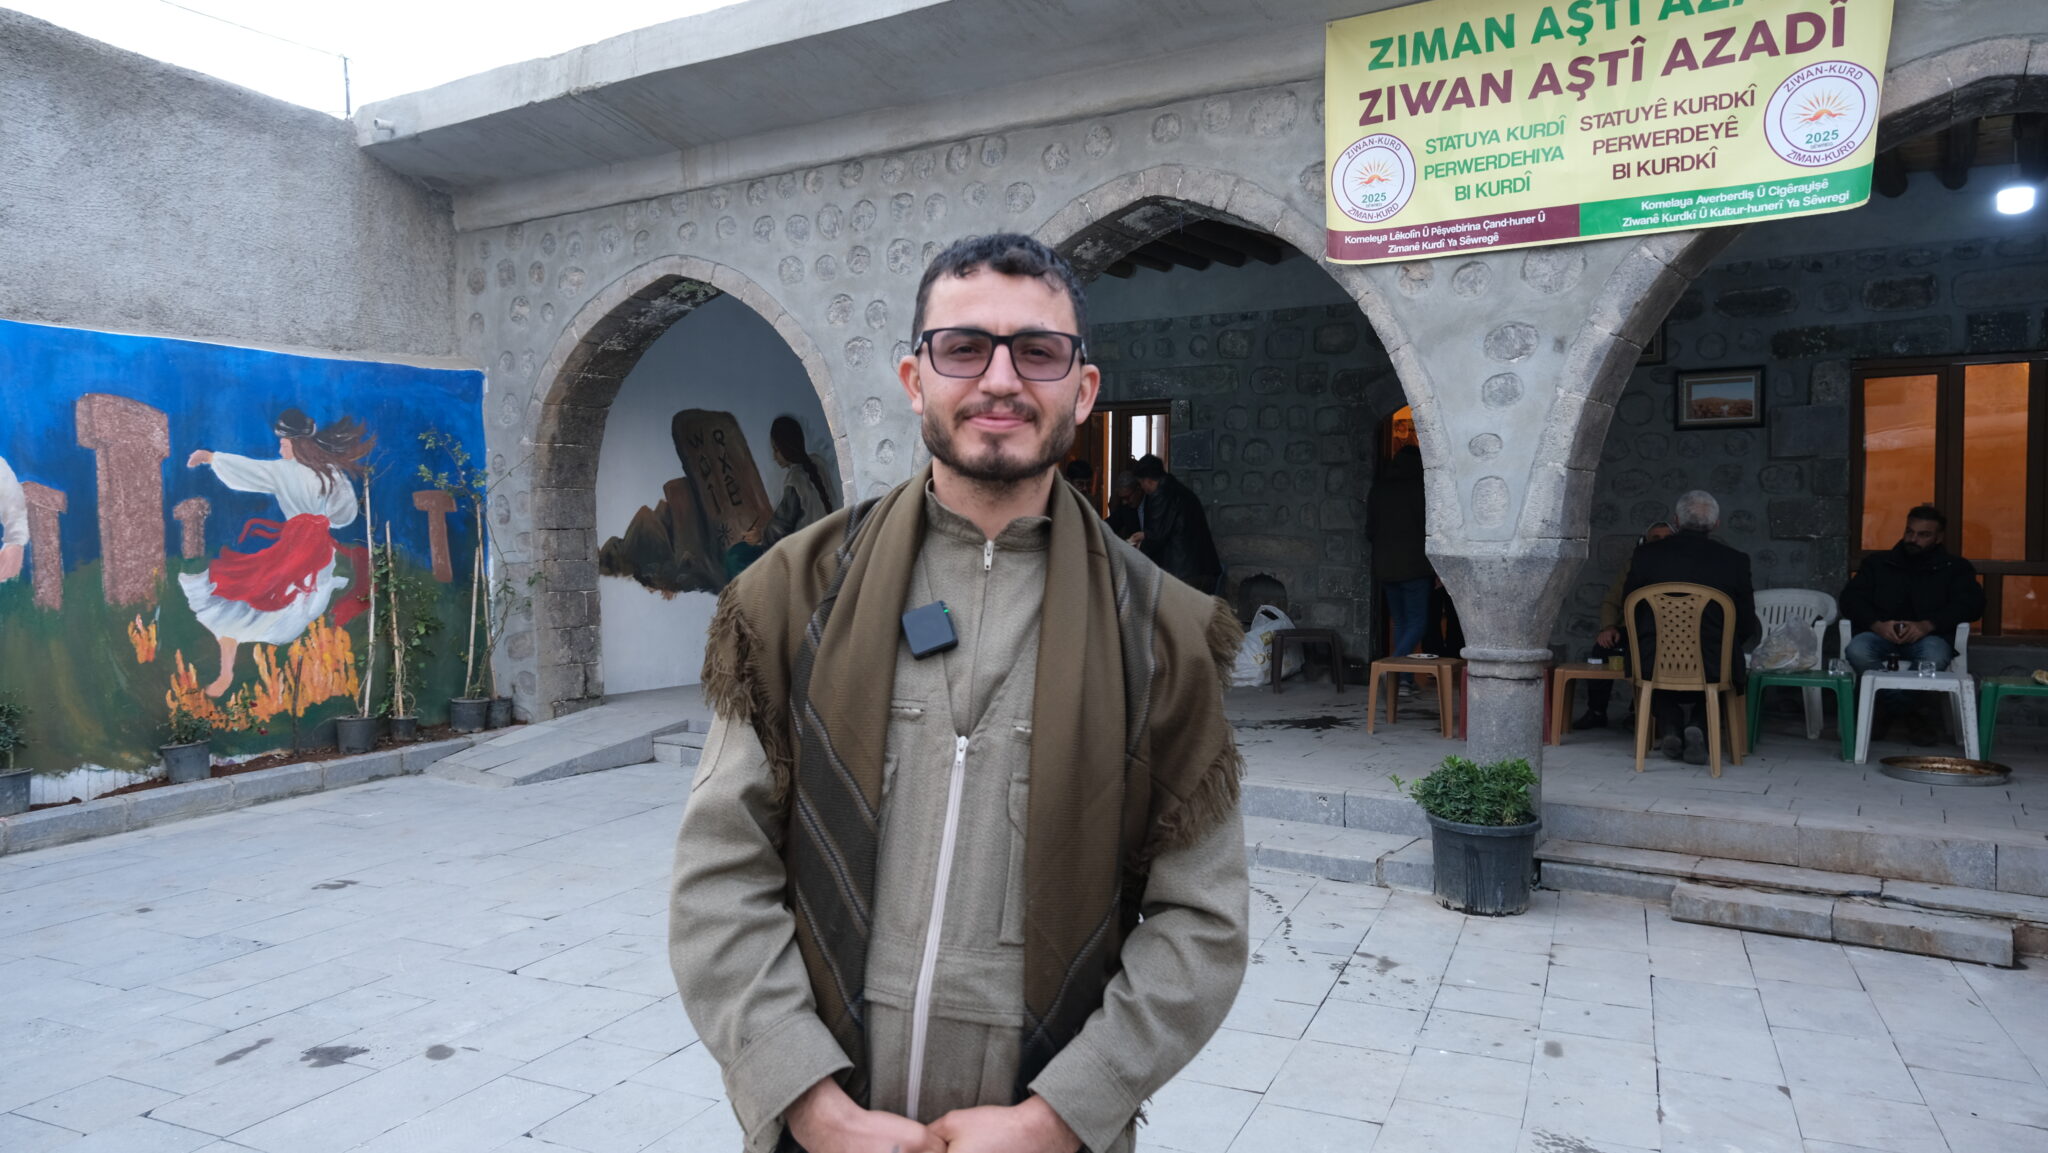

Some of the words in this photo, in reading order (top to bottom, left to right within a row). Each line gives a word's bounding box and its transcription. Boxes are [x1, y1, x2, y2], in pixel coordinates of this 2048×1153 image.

[1368, 13, 1515, 71] ZIMAN
[1358, 69, 1513, 127] ZIWAN
[1528, 34, 1647, 102] AŞTÎ
[1660, 0, 1849, 77] AZADÎ
[1784, 64, 1864, 93] ZIWAN-KURD
[1579, 97, 1668, 132] STATUYÊ
[1673, 83, 1758, 117] KURDKÎ
[1345, 136, 1402, 160] ZIWAN-KURD
[1425, 129, 1501, 155] STATUYA
[1506, 114, 1567, 142] KURDÎ
[1592, 114, 1739, 155] PERWERDEYÊ
[1805, 129, 1839, 144] 2025
[1424, 145, 1565, 180] PERWERDEHIYA
[1612, 161, 1631, 180] BI
[1636, 145, 1719, 178] KURDKÎ
[1786, 140, 1856, 163] ZIMAN-KURD
[1361, 192, 1387, 204] 2025
[1454, 184, 1471, 201] BI
[1475, 170, 1533, 199] KURDÎ
[1757, 185, 1765, 198] Û
[1347, 202, 1400, 220] ZIMAN-KURD
[1622, 213, 1660, 228] Ziwanê
[1661, 208, 1697, 223] Kurdkî
[1699, 206, 1708, 219] Û
[1786, 198, 1800, 208] Ya
[1344, 232, 1388, 245] Komeleya
[1422, 226, 1430, 238] Û
[1431, 222, 1481, 237] Pêşvebirina
[1483, 215, 1535, 231] Çand-huner
[1537, 210, 1546, 223] Û
[1387, 240, 1421, 254] Zimanê
[1421, 237, 1445, 250] Kurdî
[1447, 237, 1458, 247] Ya
[1459, 232, 1500, 246] Sêwregê
